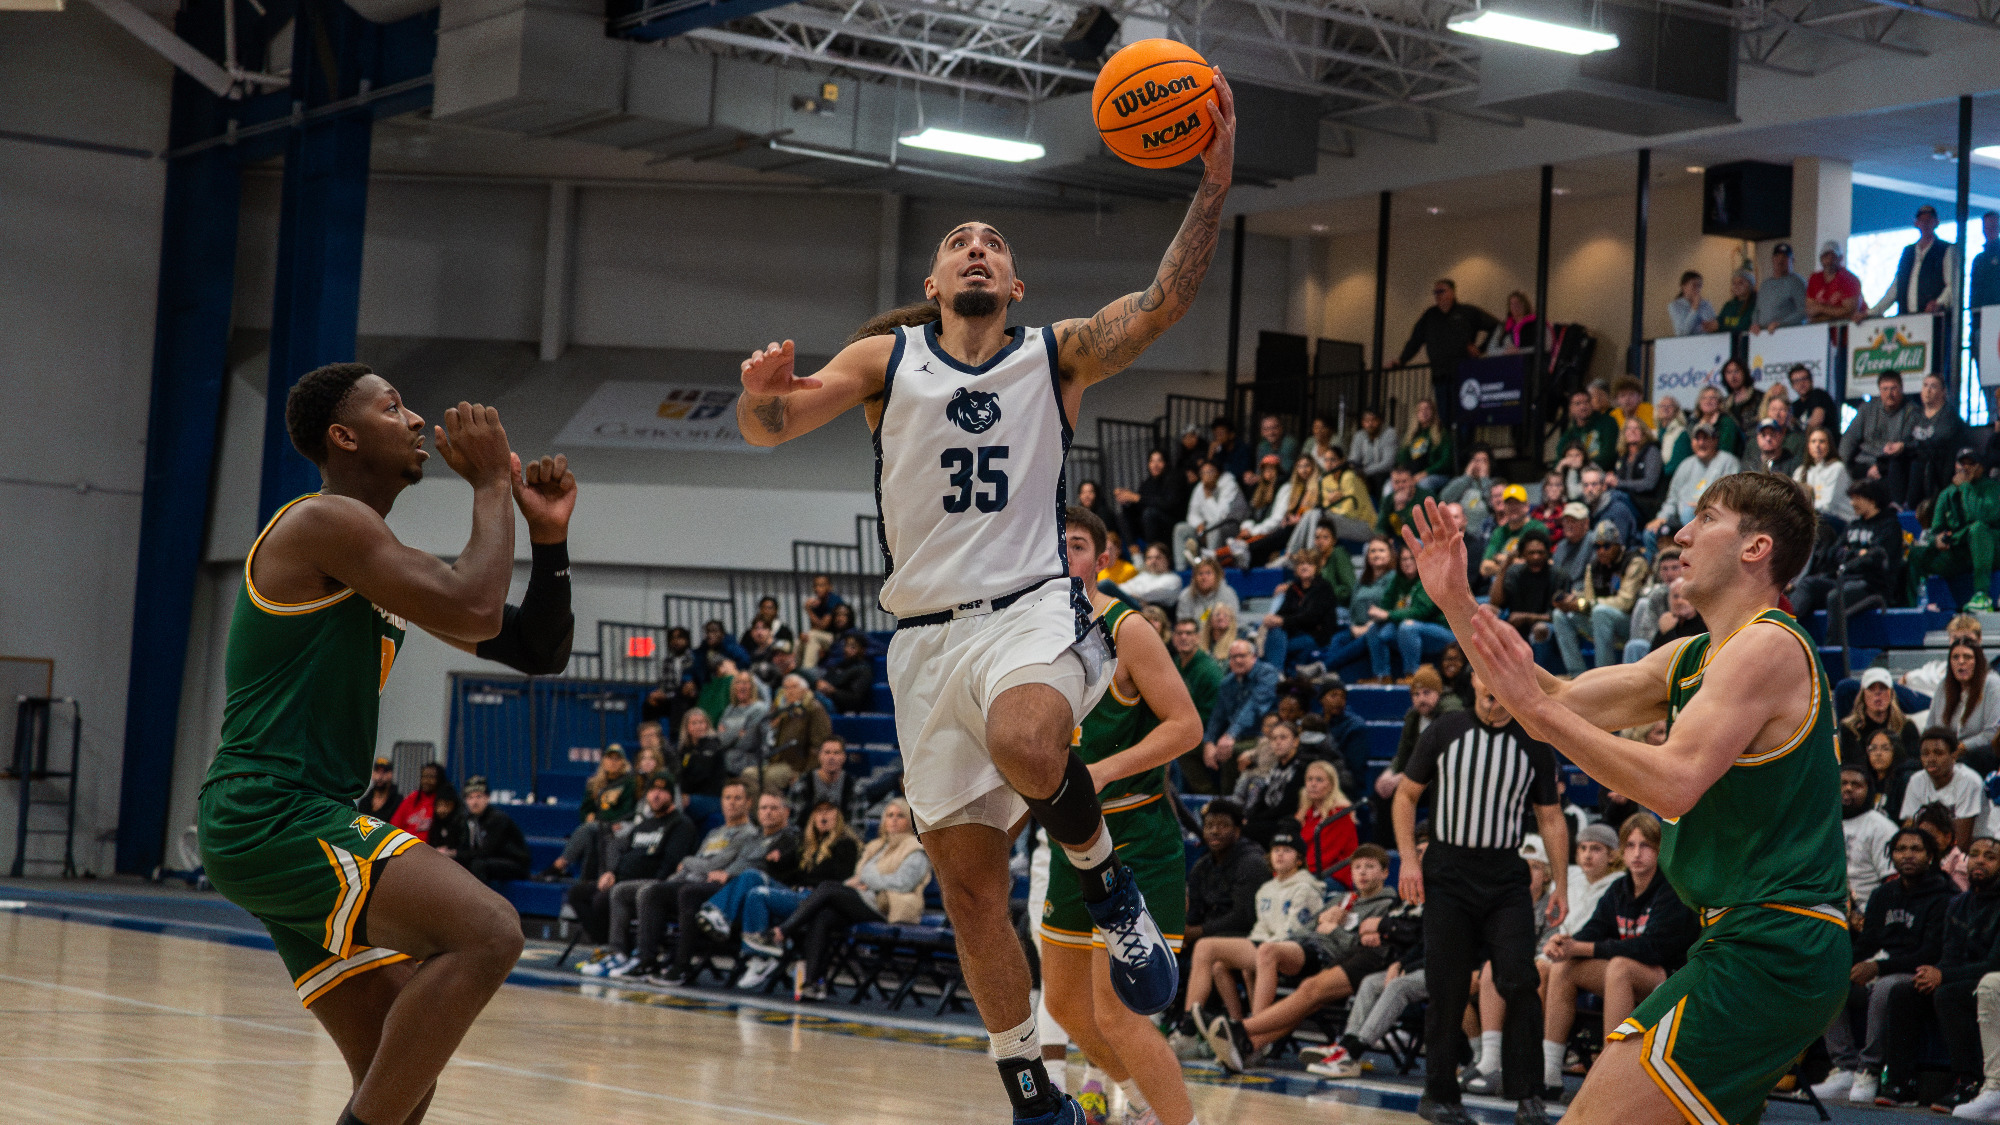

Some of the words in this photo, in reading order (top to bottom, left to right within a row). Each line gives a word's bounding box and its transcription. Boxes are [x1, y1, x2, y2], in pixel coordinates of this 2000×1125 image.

[1112, 75, 1199, 118] Wilson
[1141, 111, 1202, 149] NCAA
[1855, 351, 1892, 376] Green
[1893, 347, 1923, 370] Mill
[940, 445, 1010, 514] 35
